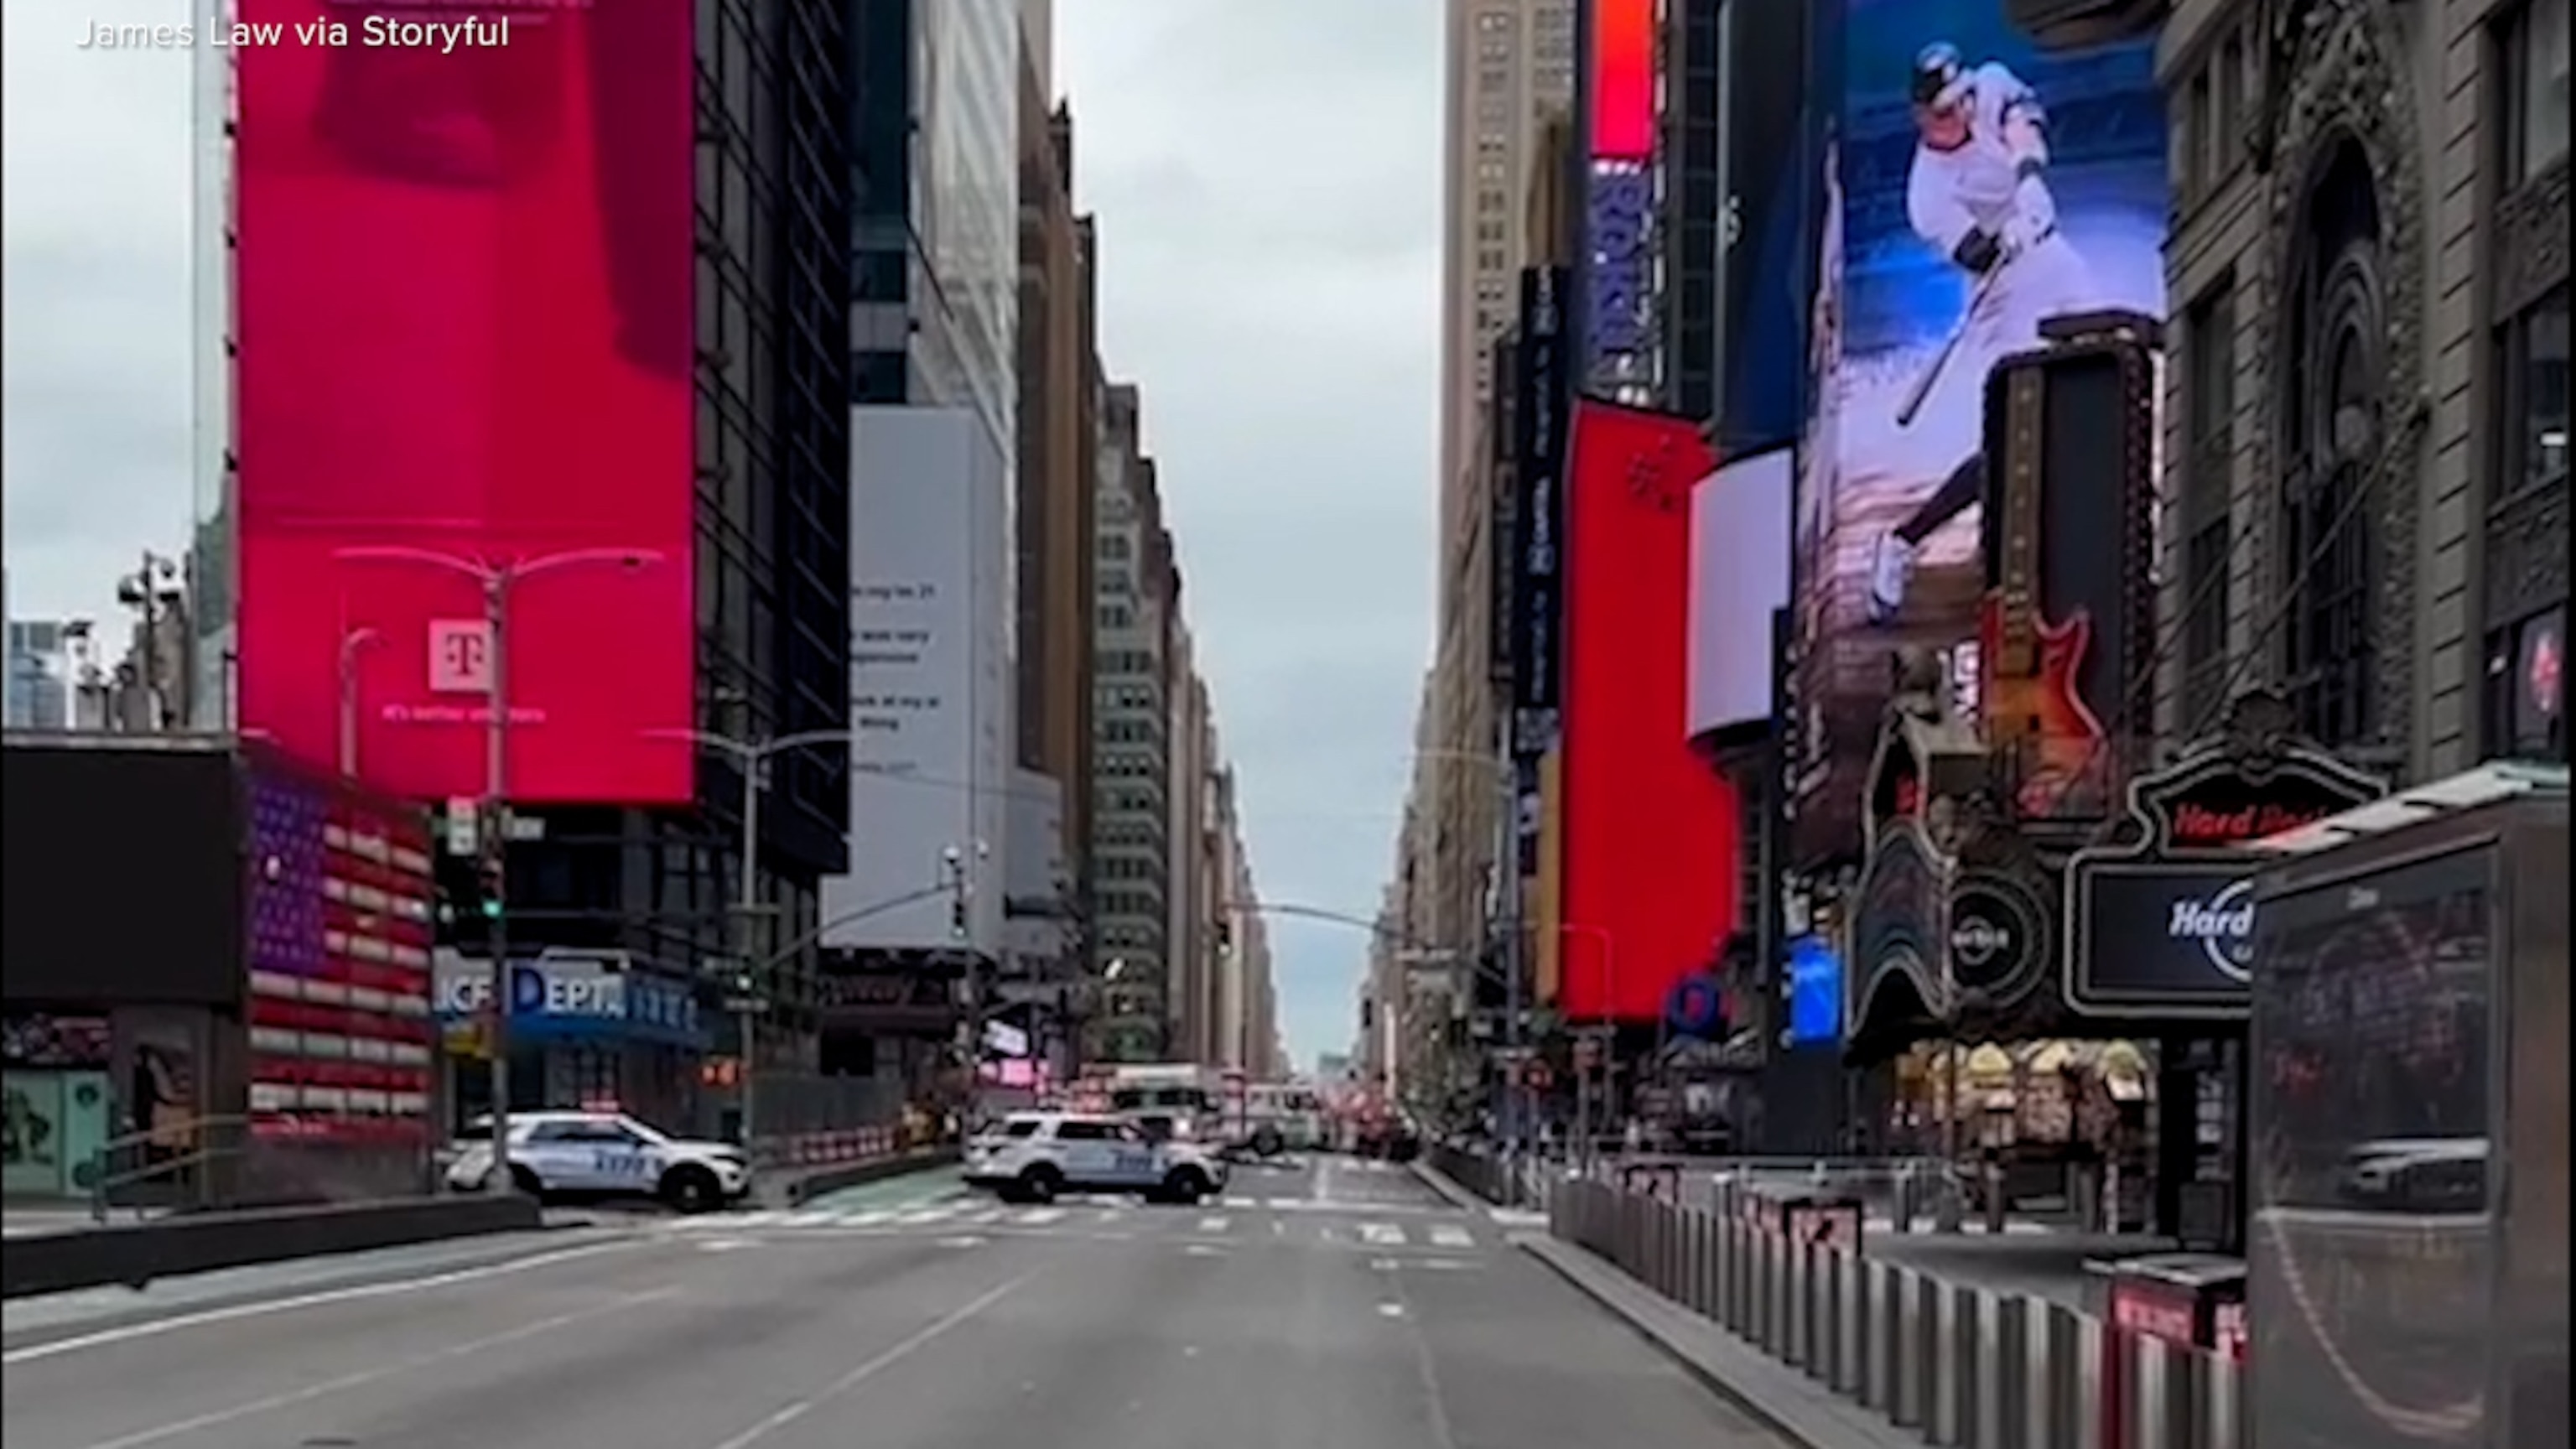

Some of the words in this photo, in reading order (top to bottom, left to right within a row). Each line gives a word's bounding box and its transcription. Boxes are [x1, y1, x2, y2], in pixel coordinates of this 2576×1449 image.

[447, 633, 484, 675] T
[2174, 802, 2257, 835] Hard
[2168, 901, 2255, 937] Hard
